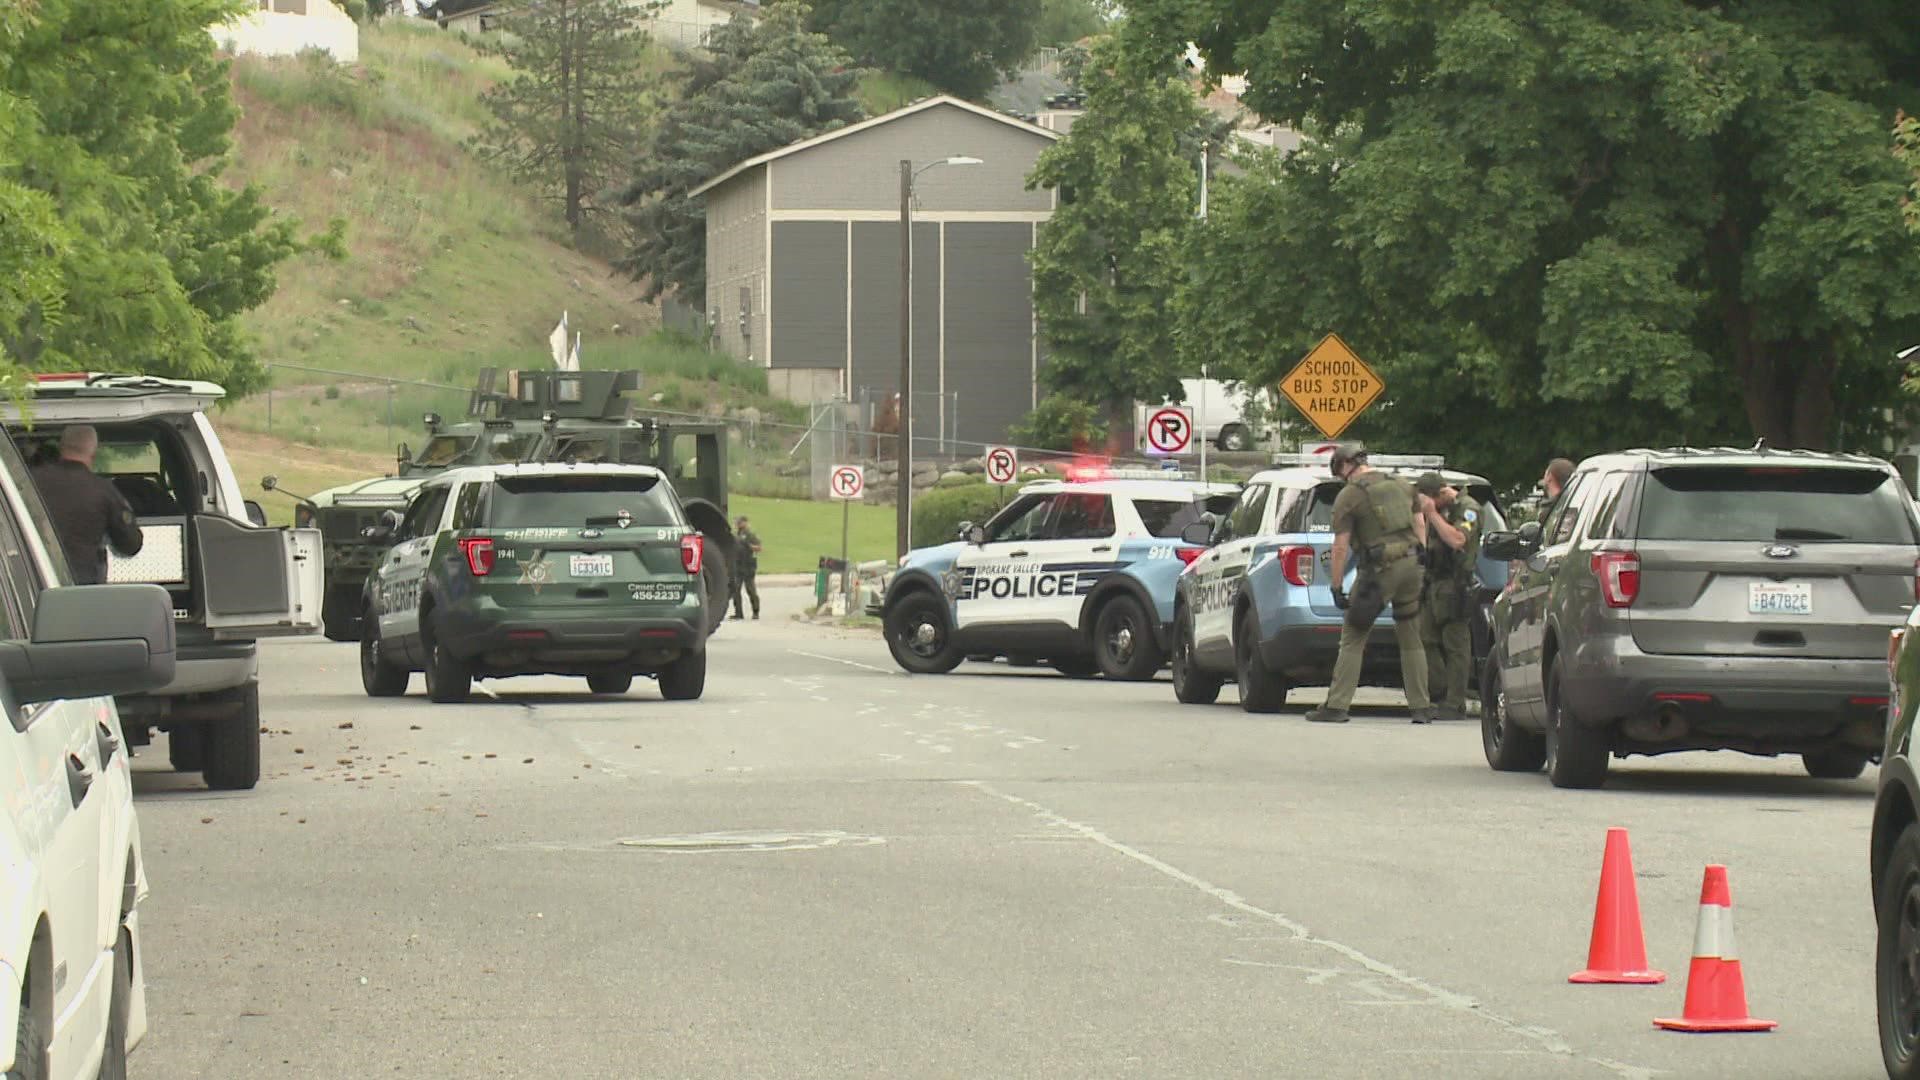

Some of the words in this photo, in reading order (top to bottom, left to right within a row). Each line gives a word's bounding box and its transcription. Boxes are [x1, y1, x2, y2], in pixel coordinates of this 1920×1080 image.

[1305, 361, 1359, 376] SCHOOL
[1294, 380, 1322, 394] BUS
[1332, 380, 1369, 394] STOP
[1309, 398, 1356, 412] AHEAD
[657, 529, 679, 541] 911
[498, 549, 515, 559] 1941
[1148, 545, 1174, 560] 911
[977, 564, 1011, 575] SPOKANE
[973, 574, 1076, 600] POLICE
[632, 591, 681, 601] 456-2233
[1201, 580, 1234, 612] POLICE
